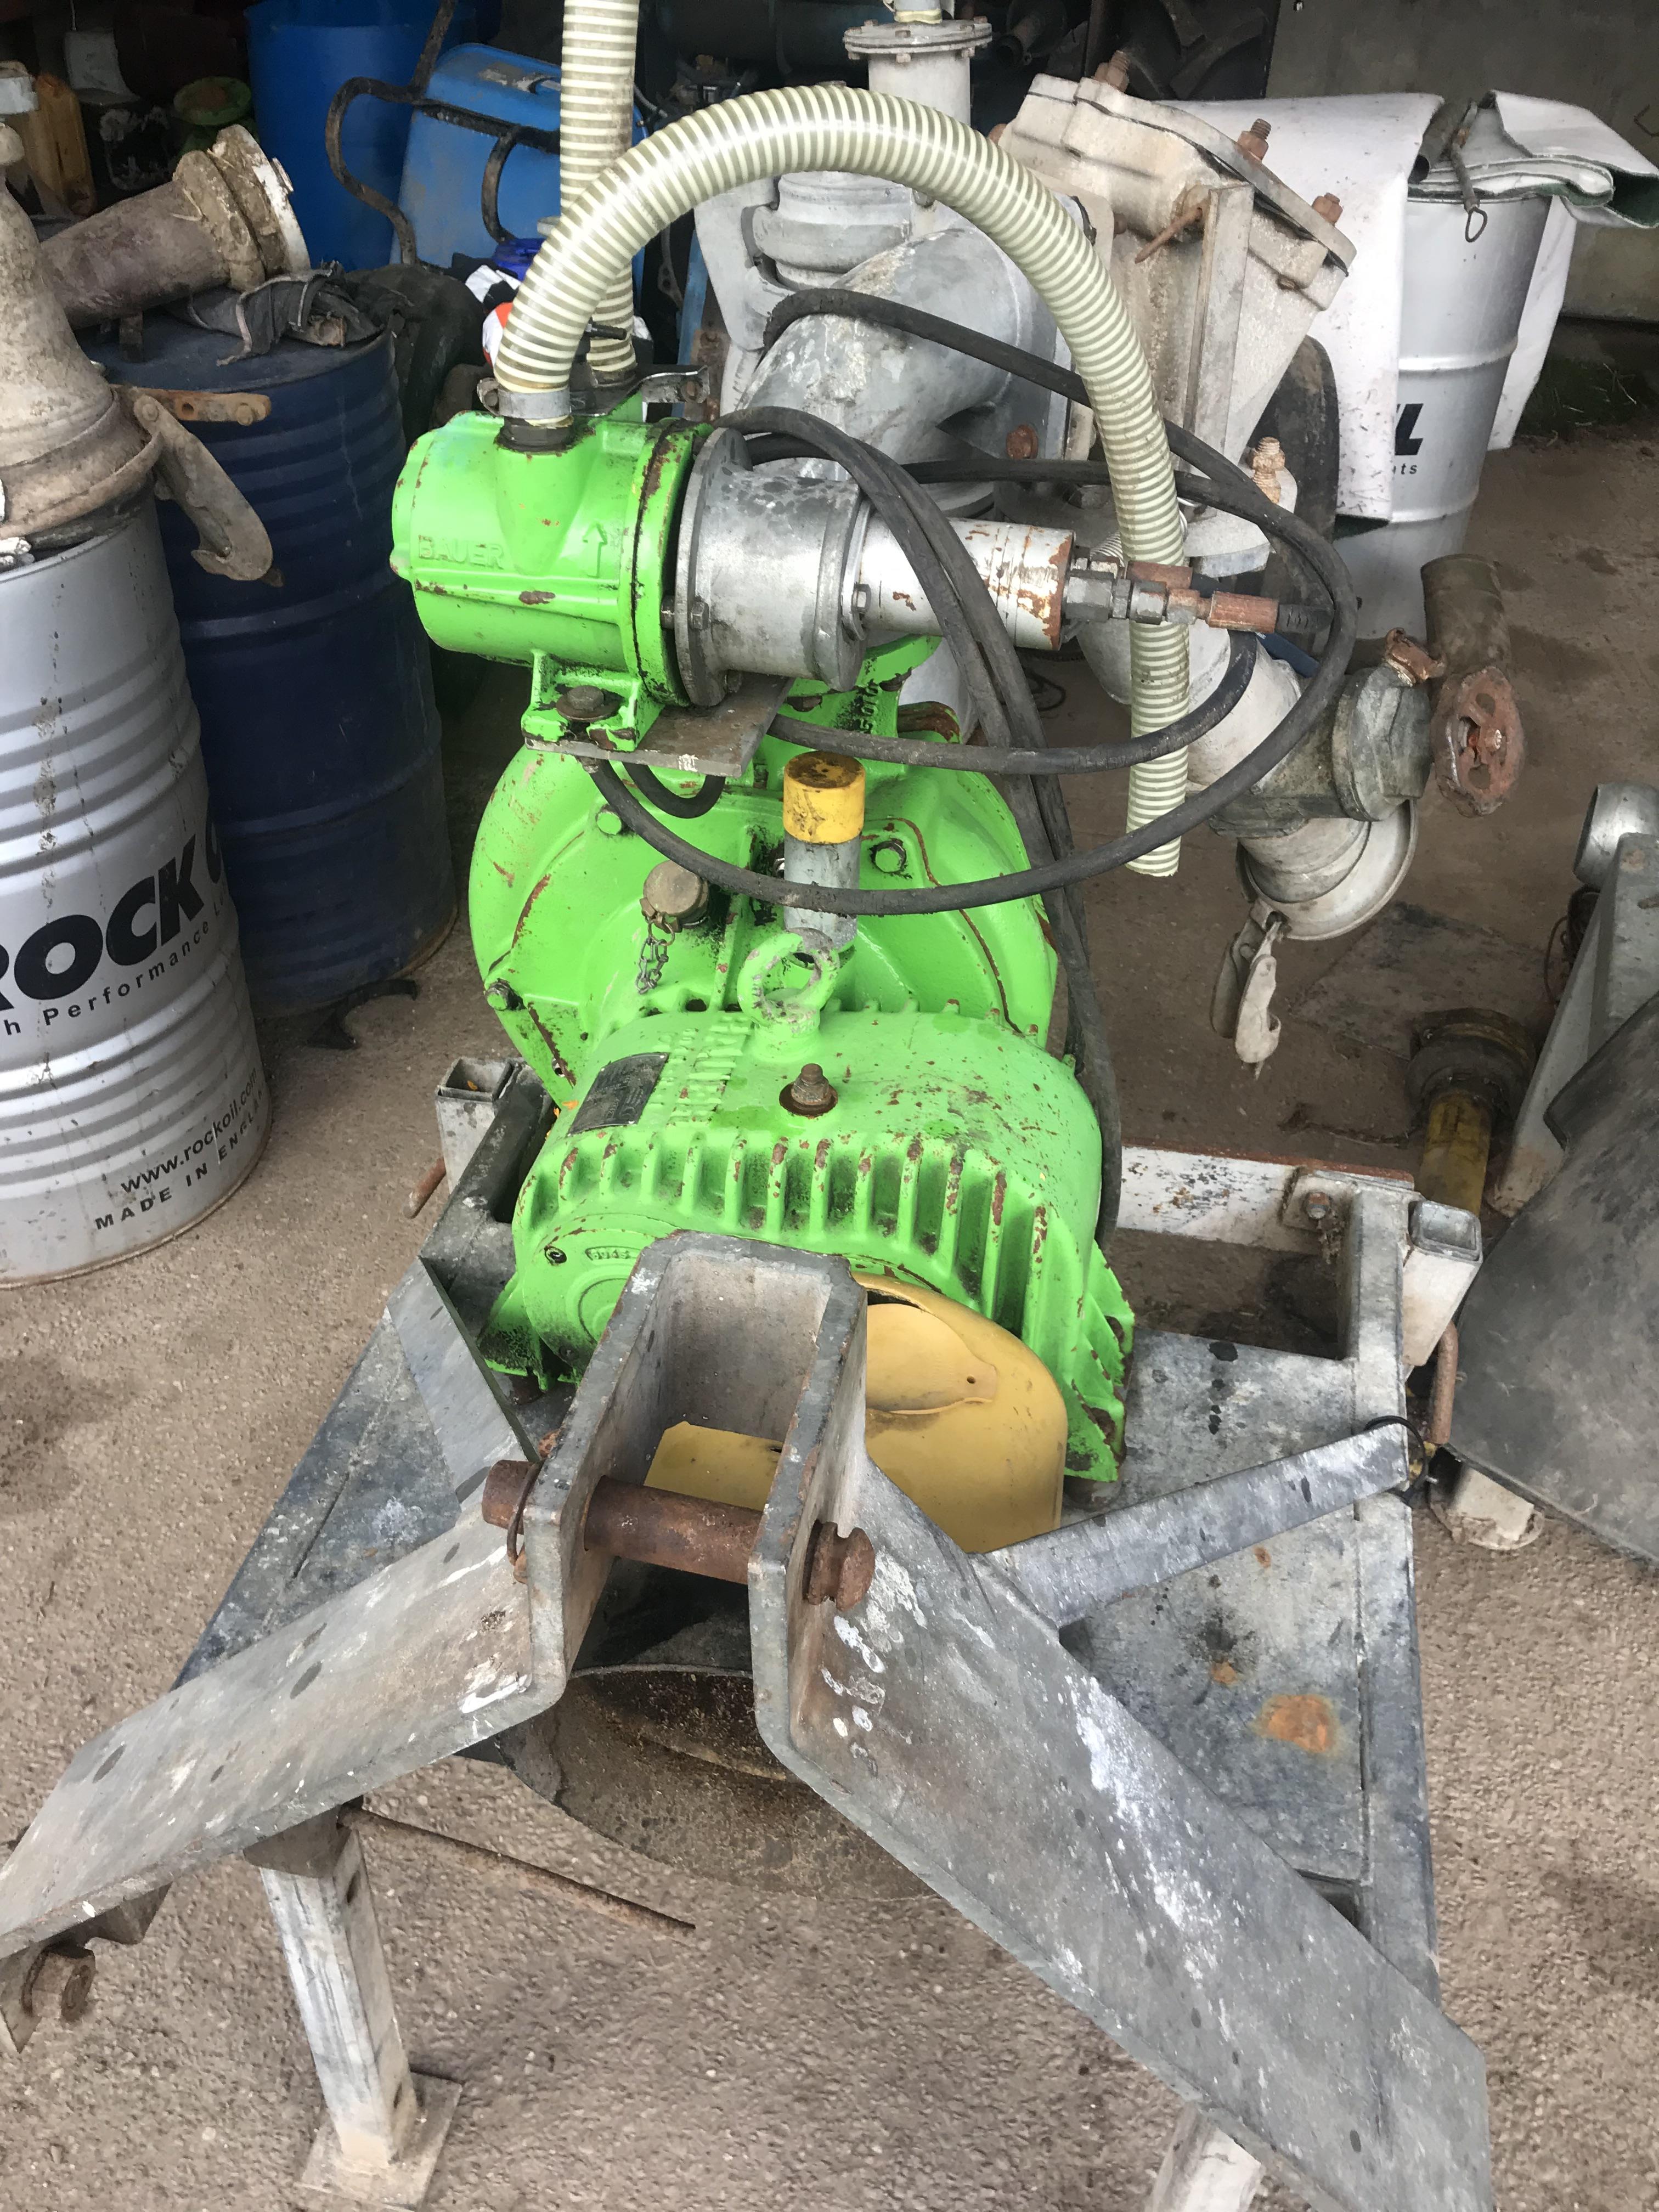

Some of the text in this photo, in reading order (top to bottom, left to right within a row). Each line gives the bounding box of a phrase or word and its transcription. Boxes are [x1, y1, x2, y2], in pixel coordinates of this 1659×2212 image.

[417, 534, 505, 570] BAUER
[0, 833, 205, 1011] OCK
[43, 921, 209, 1025] Performance
[121, 1067, 257, 1193] www.rockoil.com
[94, 1187, 173, 1230] MADE
[186, 1162, 208, 1187] IN
